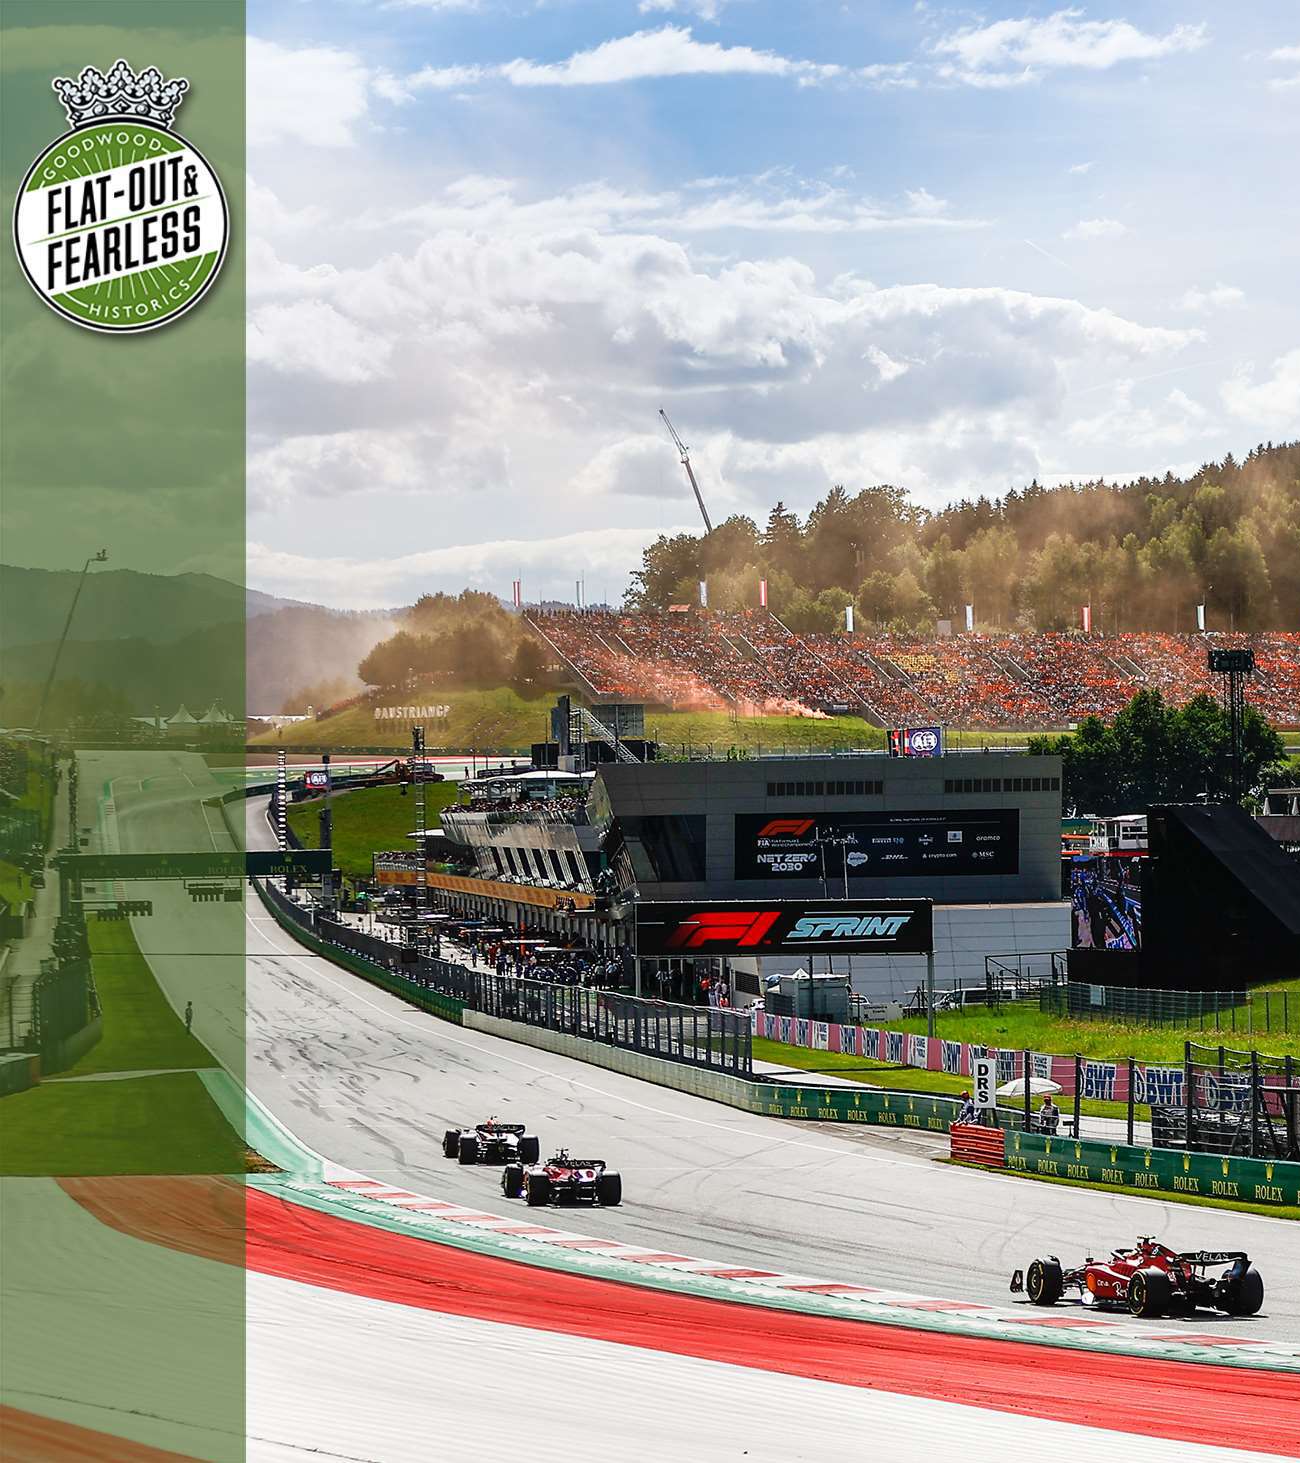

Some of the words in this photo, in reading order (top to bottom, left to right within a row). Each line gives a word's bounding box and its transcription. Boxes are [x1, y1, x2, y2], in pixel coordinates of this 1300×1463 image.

[757, 853, 783, 863] NET
[785, 853, 817, 862] ZERO
[270, 864, 308, 873] ROLEX
[772, 863, 803, 872] 2030
[787, 916, 911, 938] SPRINT
[977, 1063, 989, 1103] DRS
[1086, 1063, 1116, 1100] BWT
[1147, 1066, 1186, 1106] BWT
[818, 1108, 838, 1120] ROLEX
[847, 1109, 868, 1122] ROLEX
[878, 1112, 896, 1124] ROLEX
[1038, 1159, 1058, 1174] ROLEX
[1067, 1164, 1089, 1179] ROLEX
[1102, 1168, 1124, 1184] ROLEX
[1135, 1172, 1159, 1188] ROLEX
[1174, 1176, 1199, 1192] ROLEX
[1212, 1181, 1238, 1196] ROLEX
[1255, 1184, 1283, 1202] ROLEX
[1195, 1252, 1229, 1261] VELAS
